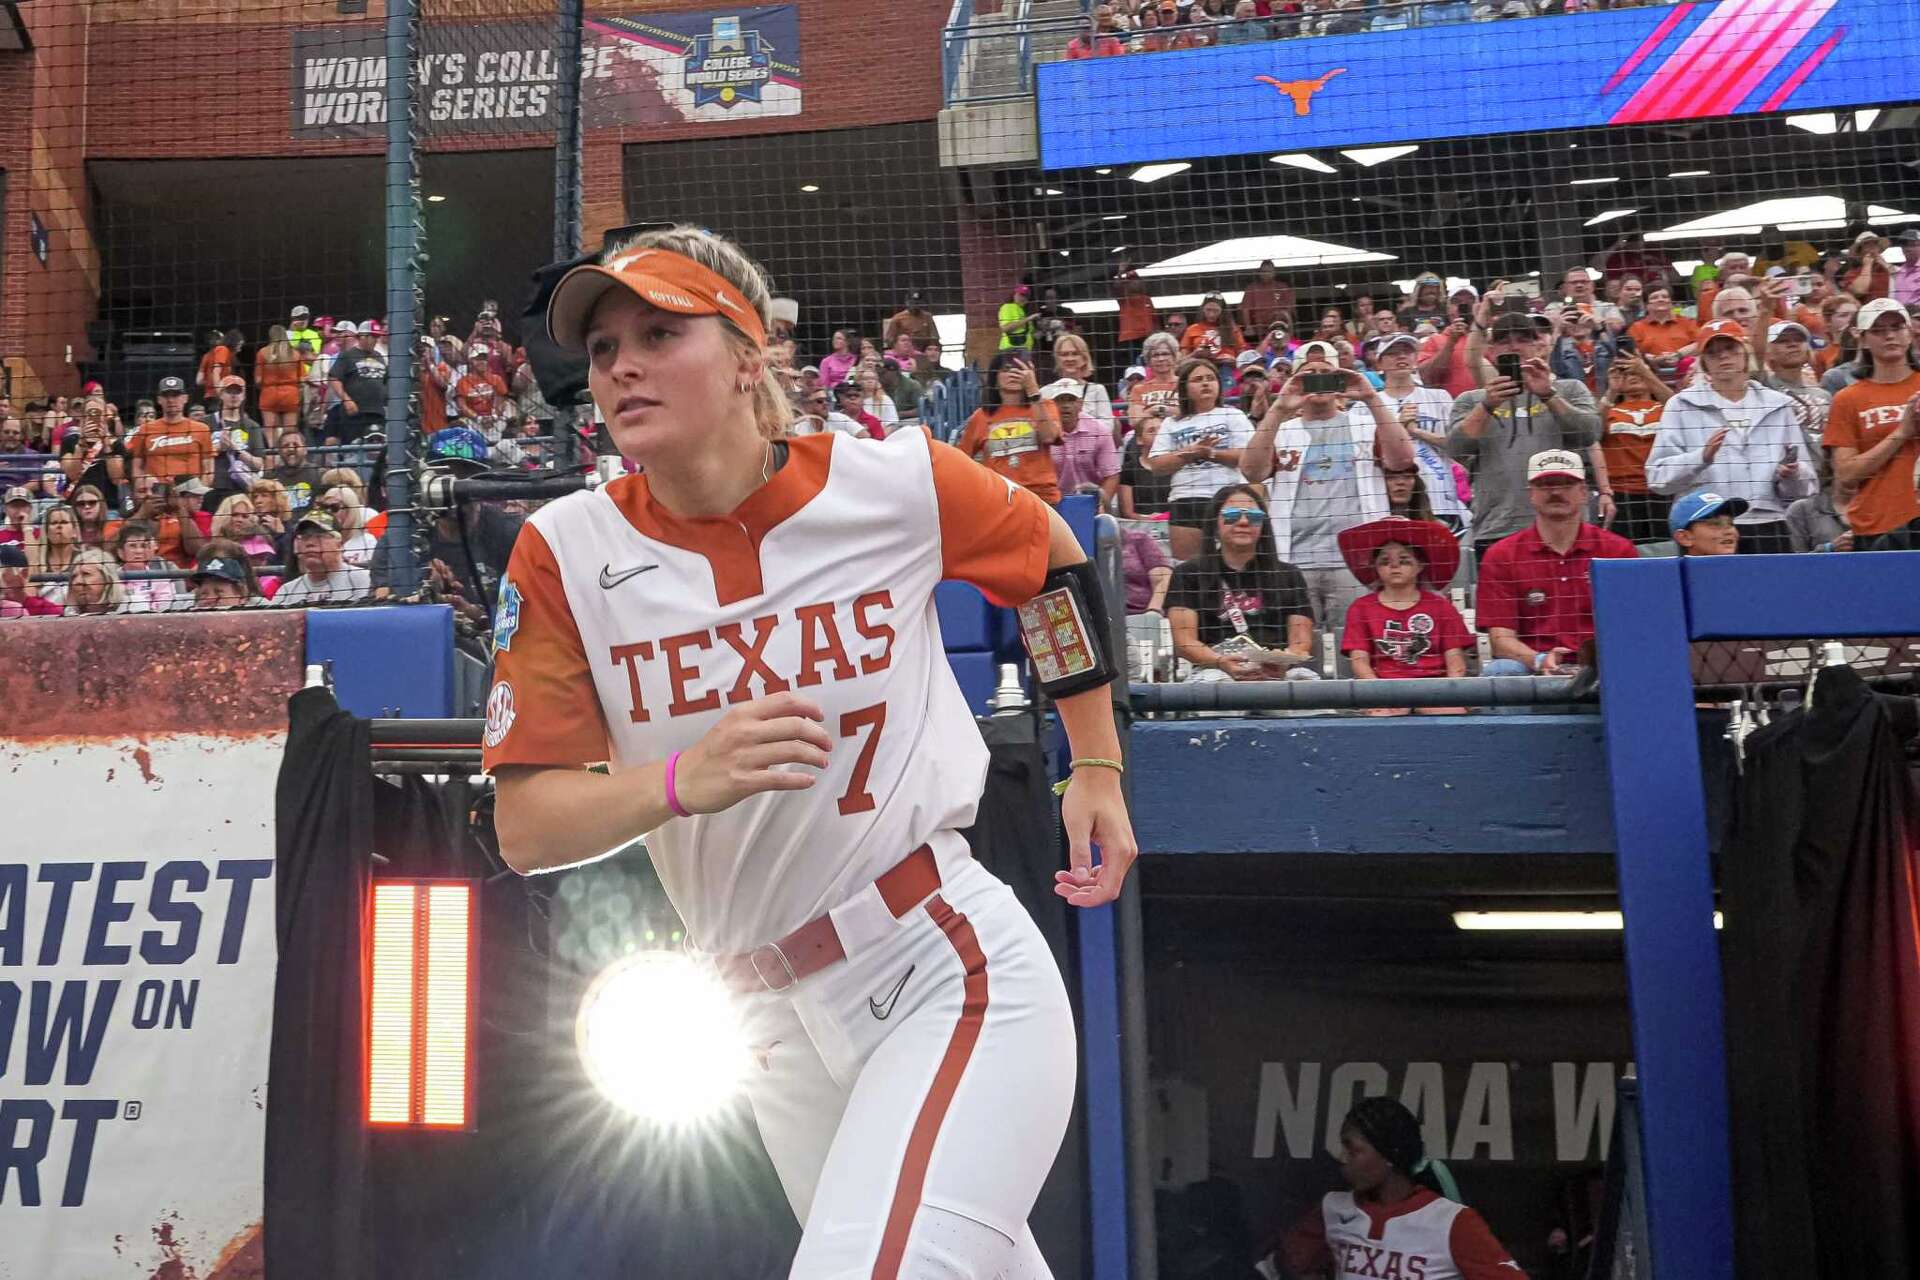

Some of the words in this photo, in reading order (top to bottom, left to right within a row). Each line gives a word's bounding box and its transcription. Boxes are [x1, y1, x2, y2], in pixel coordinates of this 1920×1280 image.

[304, 53, 467, 90] WOMN'S
[474, 46, 617, 84] COLLGE
[703, 56, 752, 71] COLLEGE
[727, 67, 769, 81] SERIES
[304, 91, 388, 125] WOR
[429, 85, 551, 121] SERIES
[609, 588, 896, 724] TEXAS
[836, 700, 888, 817] 7
[131, 979, 201, 1030] ON
[1253, 1062, 1514, 1163] NCAA
